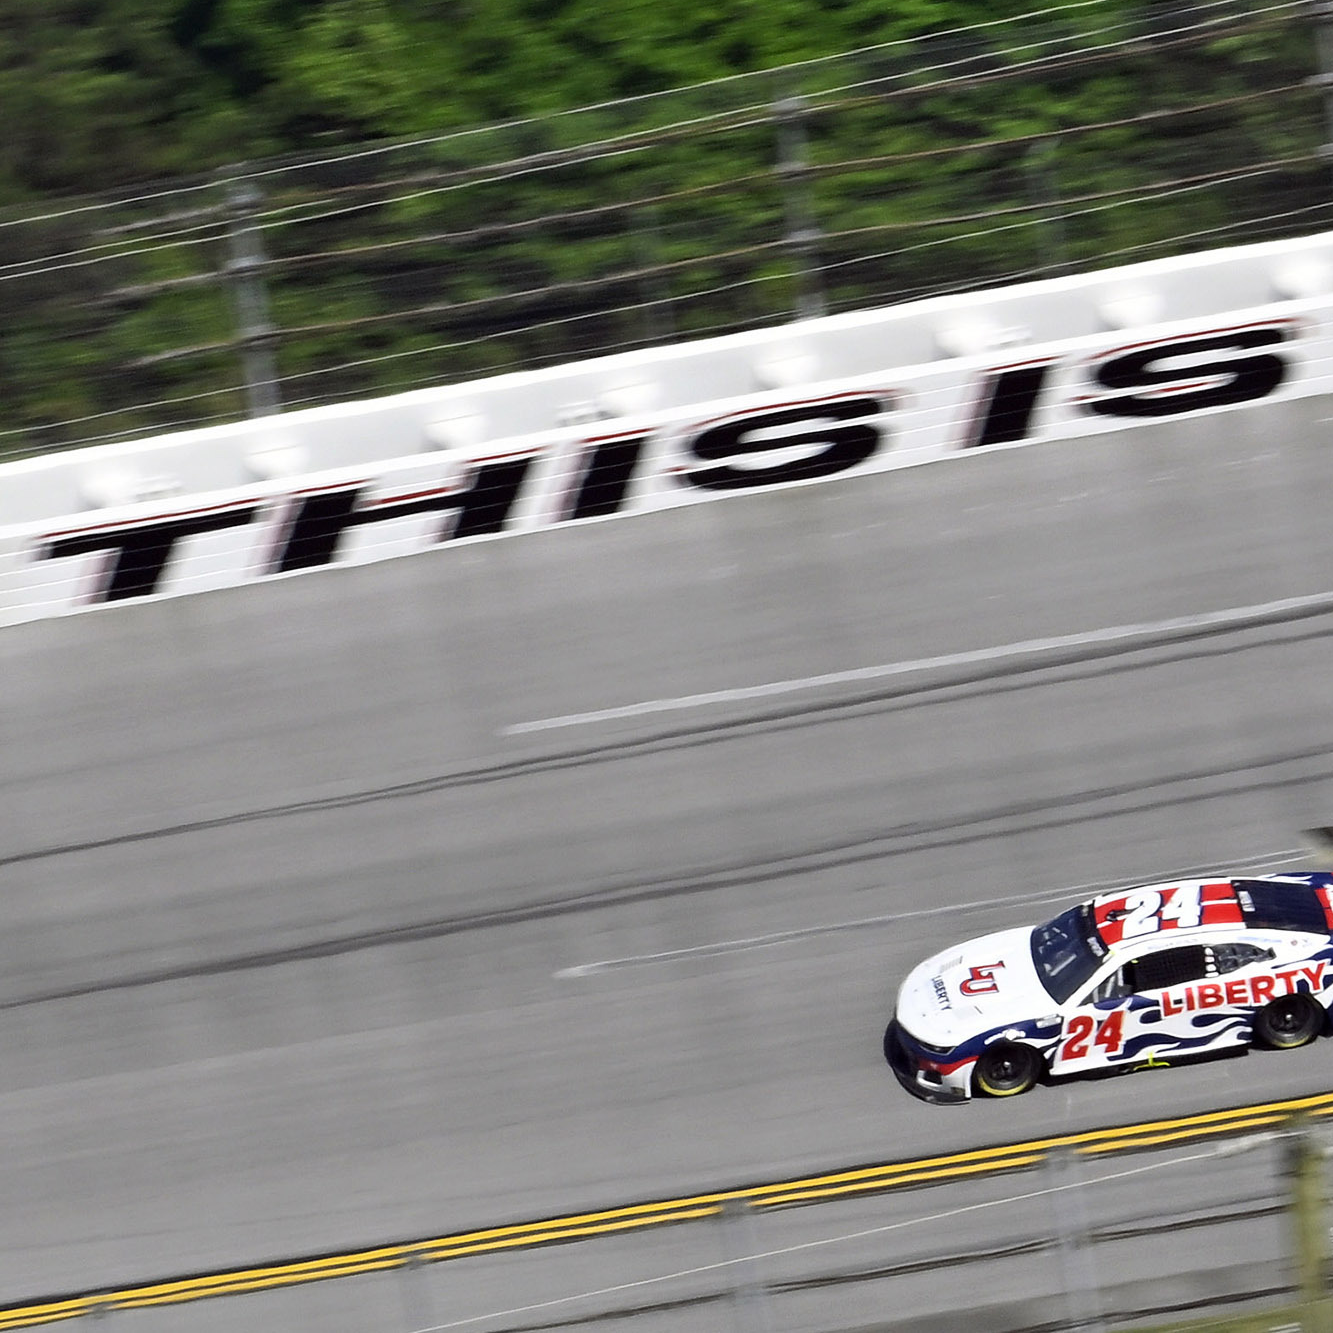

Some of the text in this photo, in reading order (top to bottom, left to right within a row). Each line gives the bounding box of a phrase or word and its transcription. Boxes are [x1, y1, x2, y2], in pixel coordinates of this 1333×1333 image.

[36, 388, 898, 604] THIS
[968, 318, 1300, 447] IS
[1122, 885, 1203, 940] 24
[932, 975, 952, 1011] LIBERTY
[1161, 961, 1328, 1017] LIBERTY
[1061, 1010, 1125, 1061] 24
